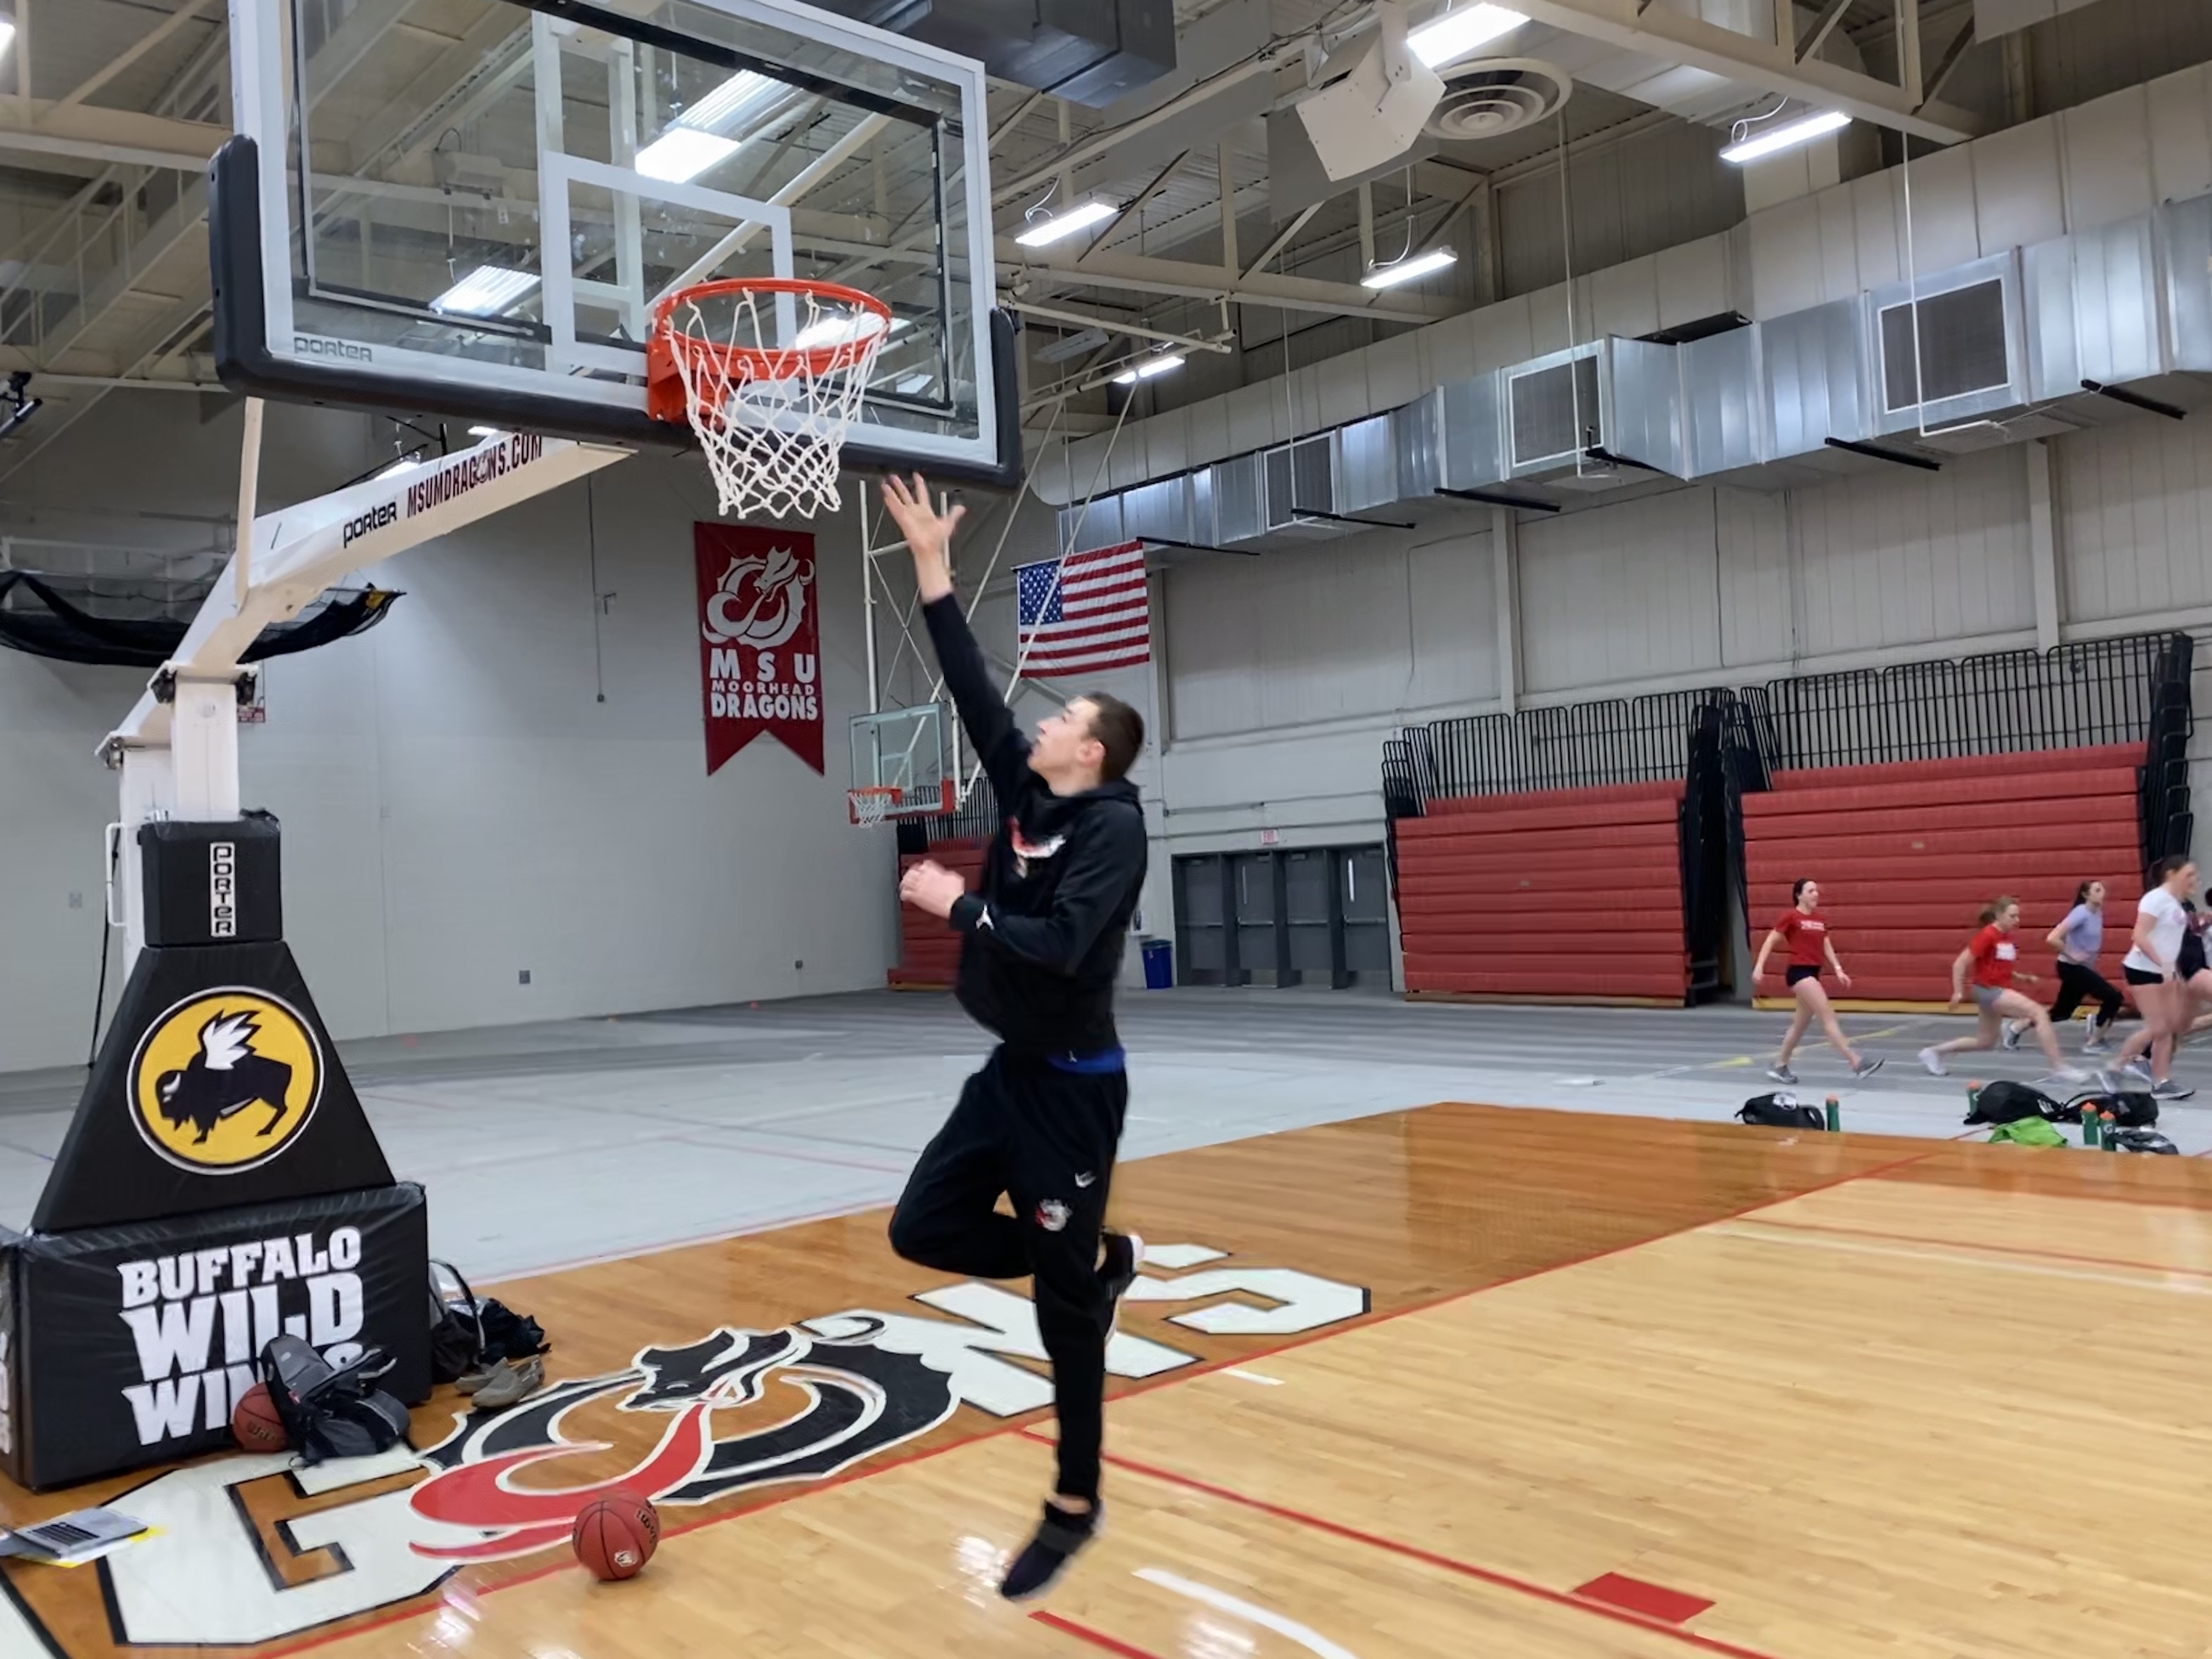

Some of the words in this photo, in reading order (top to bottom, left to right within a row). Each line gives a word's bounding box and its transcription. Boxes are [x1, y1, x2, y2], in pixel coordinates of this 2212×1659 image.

[710, 692, 818, 720] DRAGONS
[712, 680, 815, 696] MOORHEAD
[117, 1226, 362, 1308] BUFFALO
[119, 1270, 364, 1382] WILD
